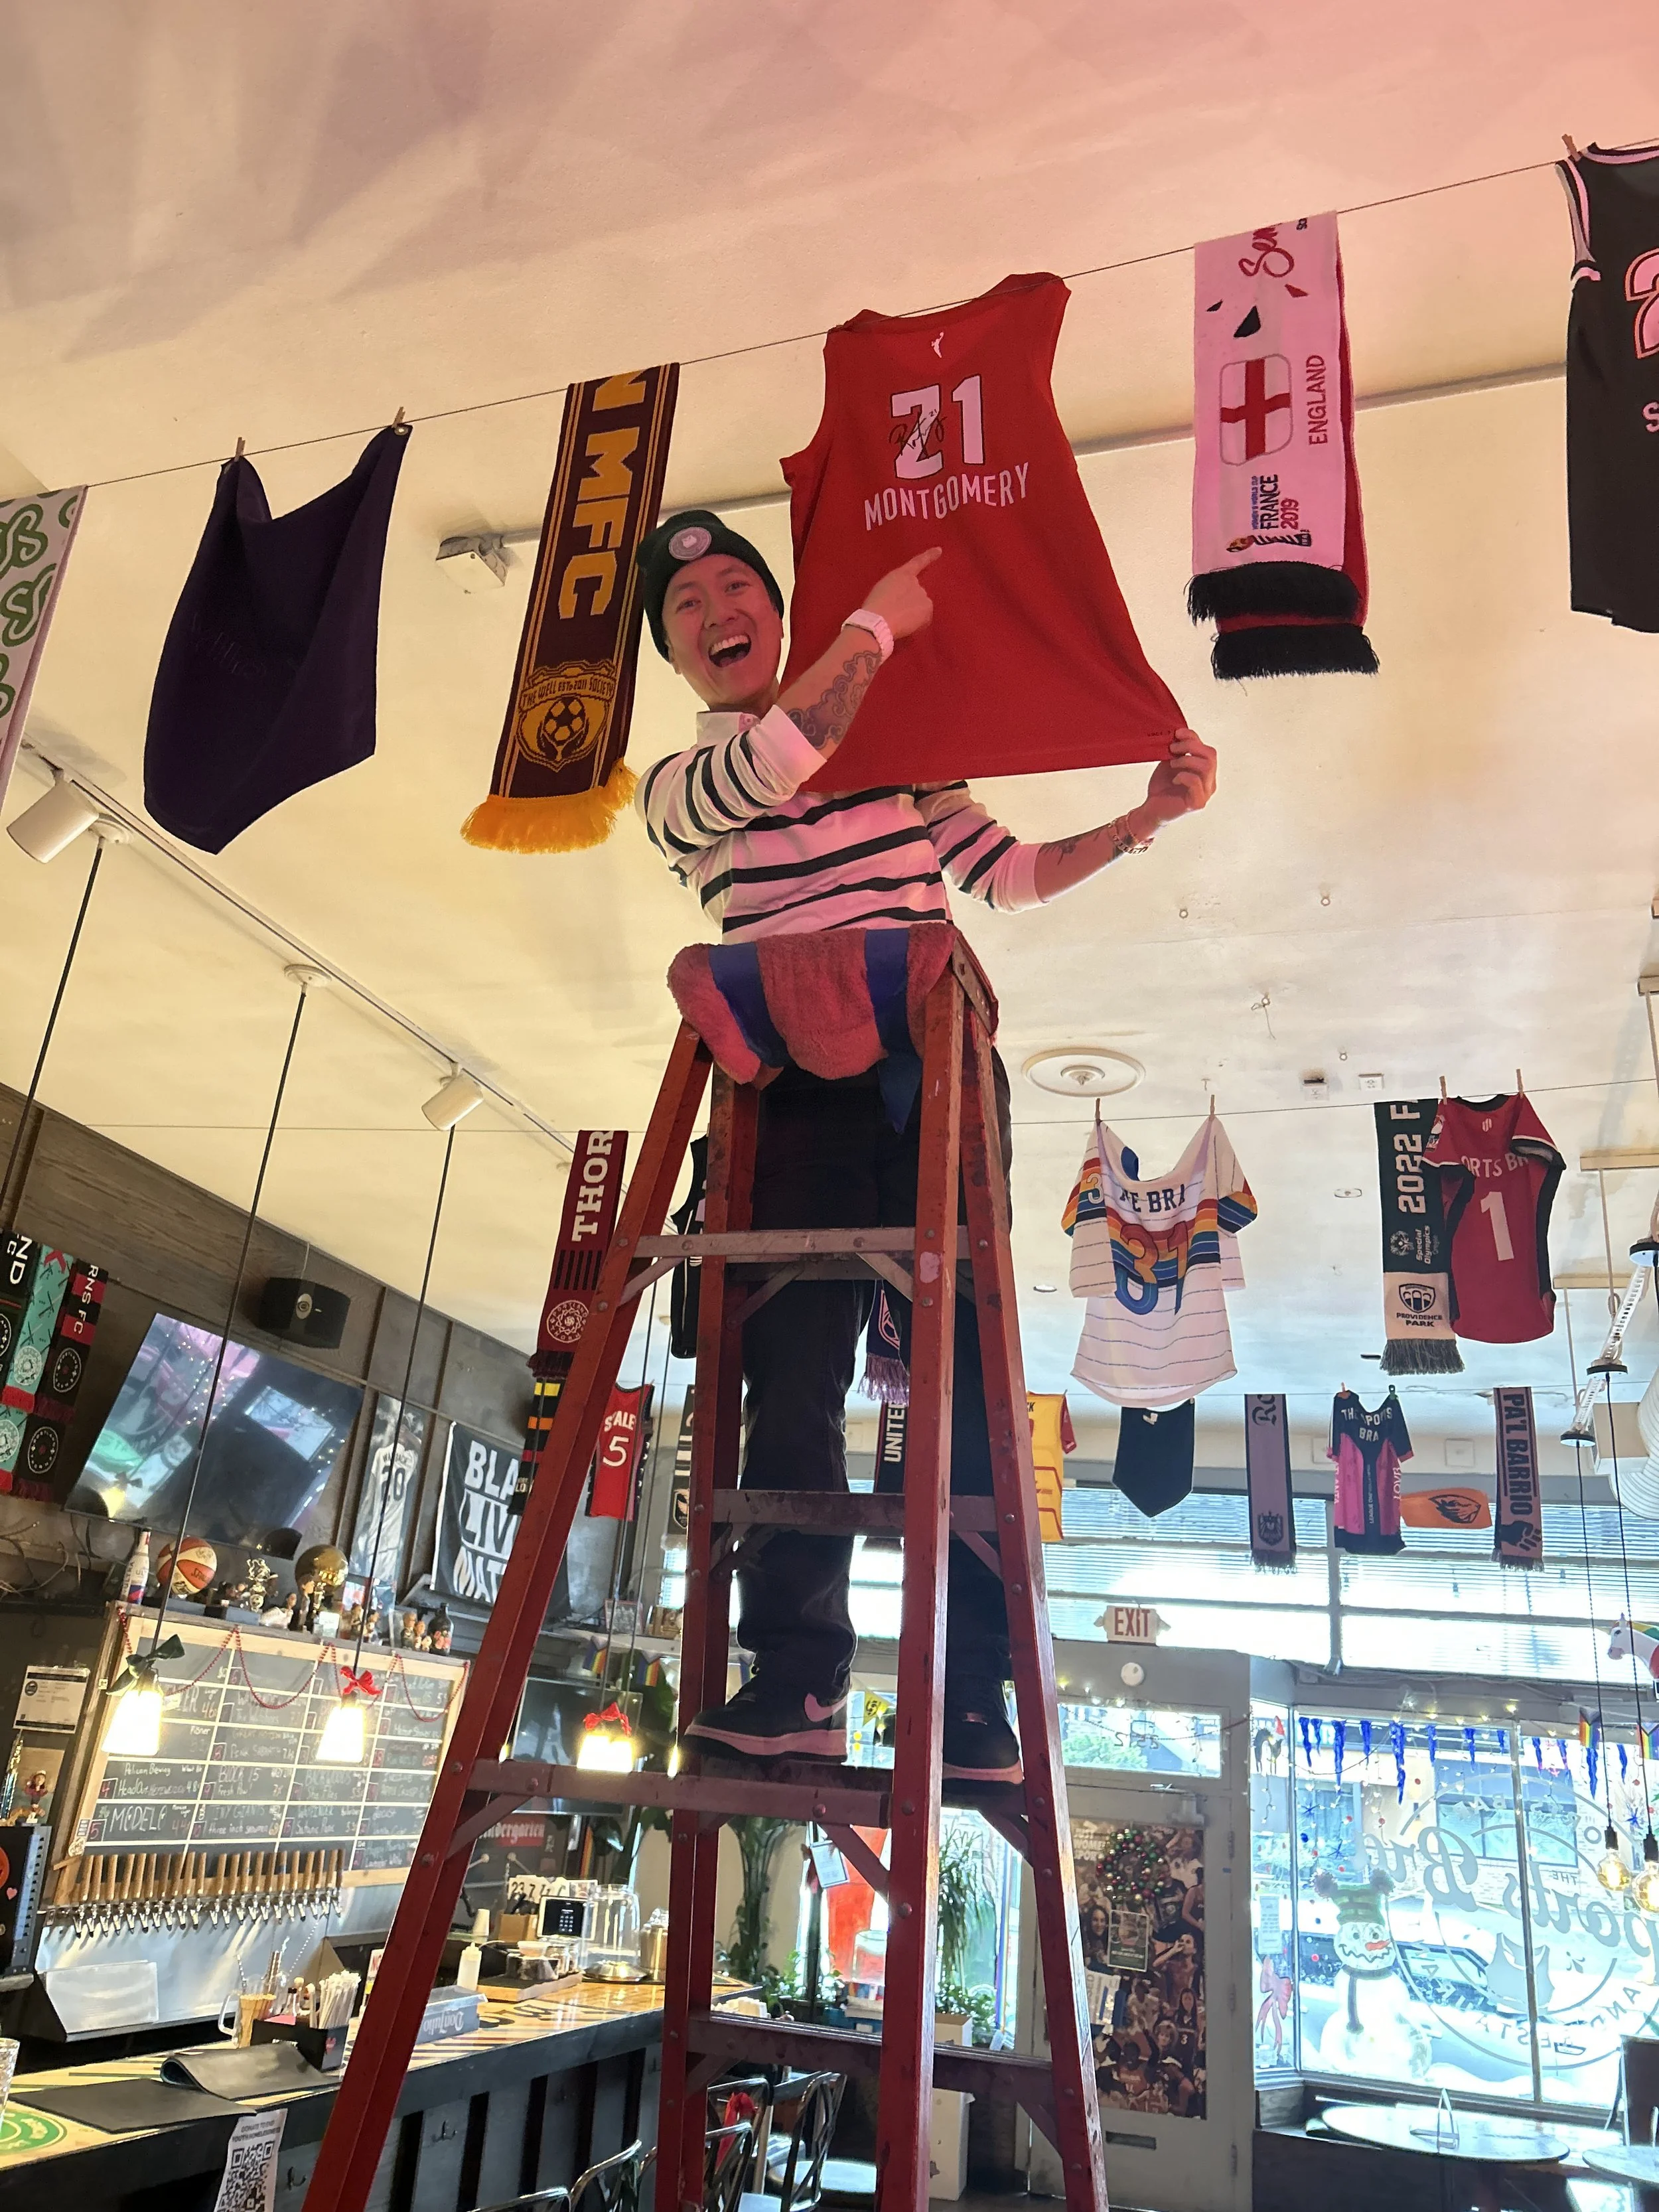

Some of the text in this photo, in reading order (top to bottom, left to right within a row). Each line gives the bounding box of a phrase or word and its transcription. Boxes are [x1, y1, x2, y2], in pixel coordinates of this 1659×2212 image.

[1305, 354, 1329, 446] ENGLAND
[891, 373, 985, 480] 21
[864, 461, 1029, 531] MONTGOMERY
[1260, 474, 1279, 530] FRANCE
[1280, 498, 1299, 530] 2019
[559, 427, 640, 620] MFC
[1394, 1134, 1427, 1214] 2022
[1461, 1153, 1530, 1179] ORTS BR
[571, 1131, 614, 1242] THOR
[1086, 1173, 1104, 1205] 3
[1415, 1228, 1423, 1261] Special
[1423, 1226, 1432, 1264] Olympics
[1480, 1191, 1515, 1262] 1
[73, 1309, 87, 1335] FC
[1396, 1312, 1443, 1321] PROVIDENCE
[603, 1435, 629, 1467] 5
[1359, 1427, 1380, 1442] BRA
[465, 1440, 520, 1501] BLA
[1506, 1438, 1534, 1516] BARRIO
[465, 1493, 518, 1560] LIV
[1114, 1607, 1151, 1637] EXIT
[478, 1822, 545, 1845] indergarten
[1181, 2033, 1188, 2045] 3
